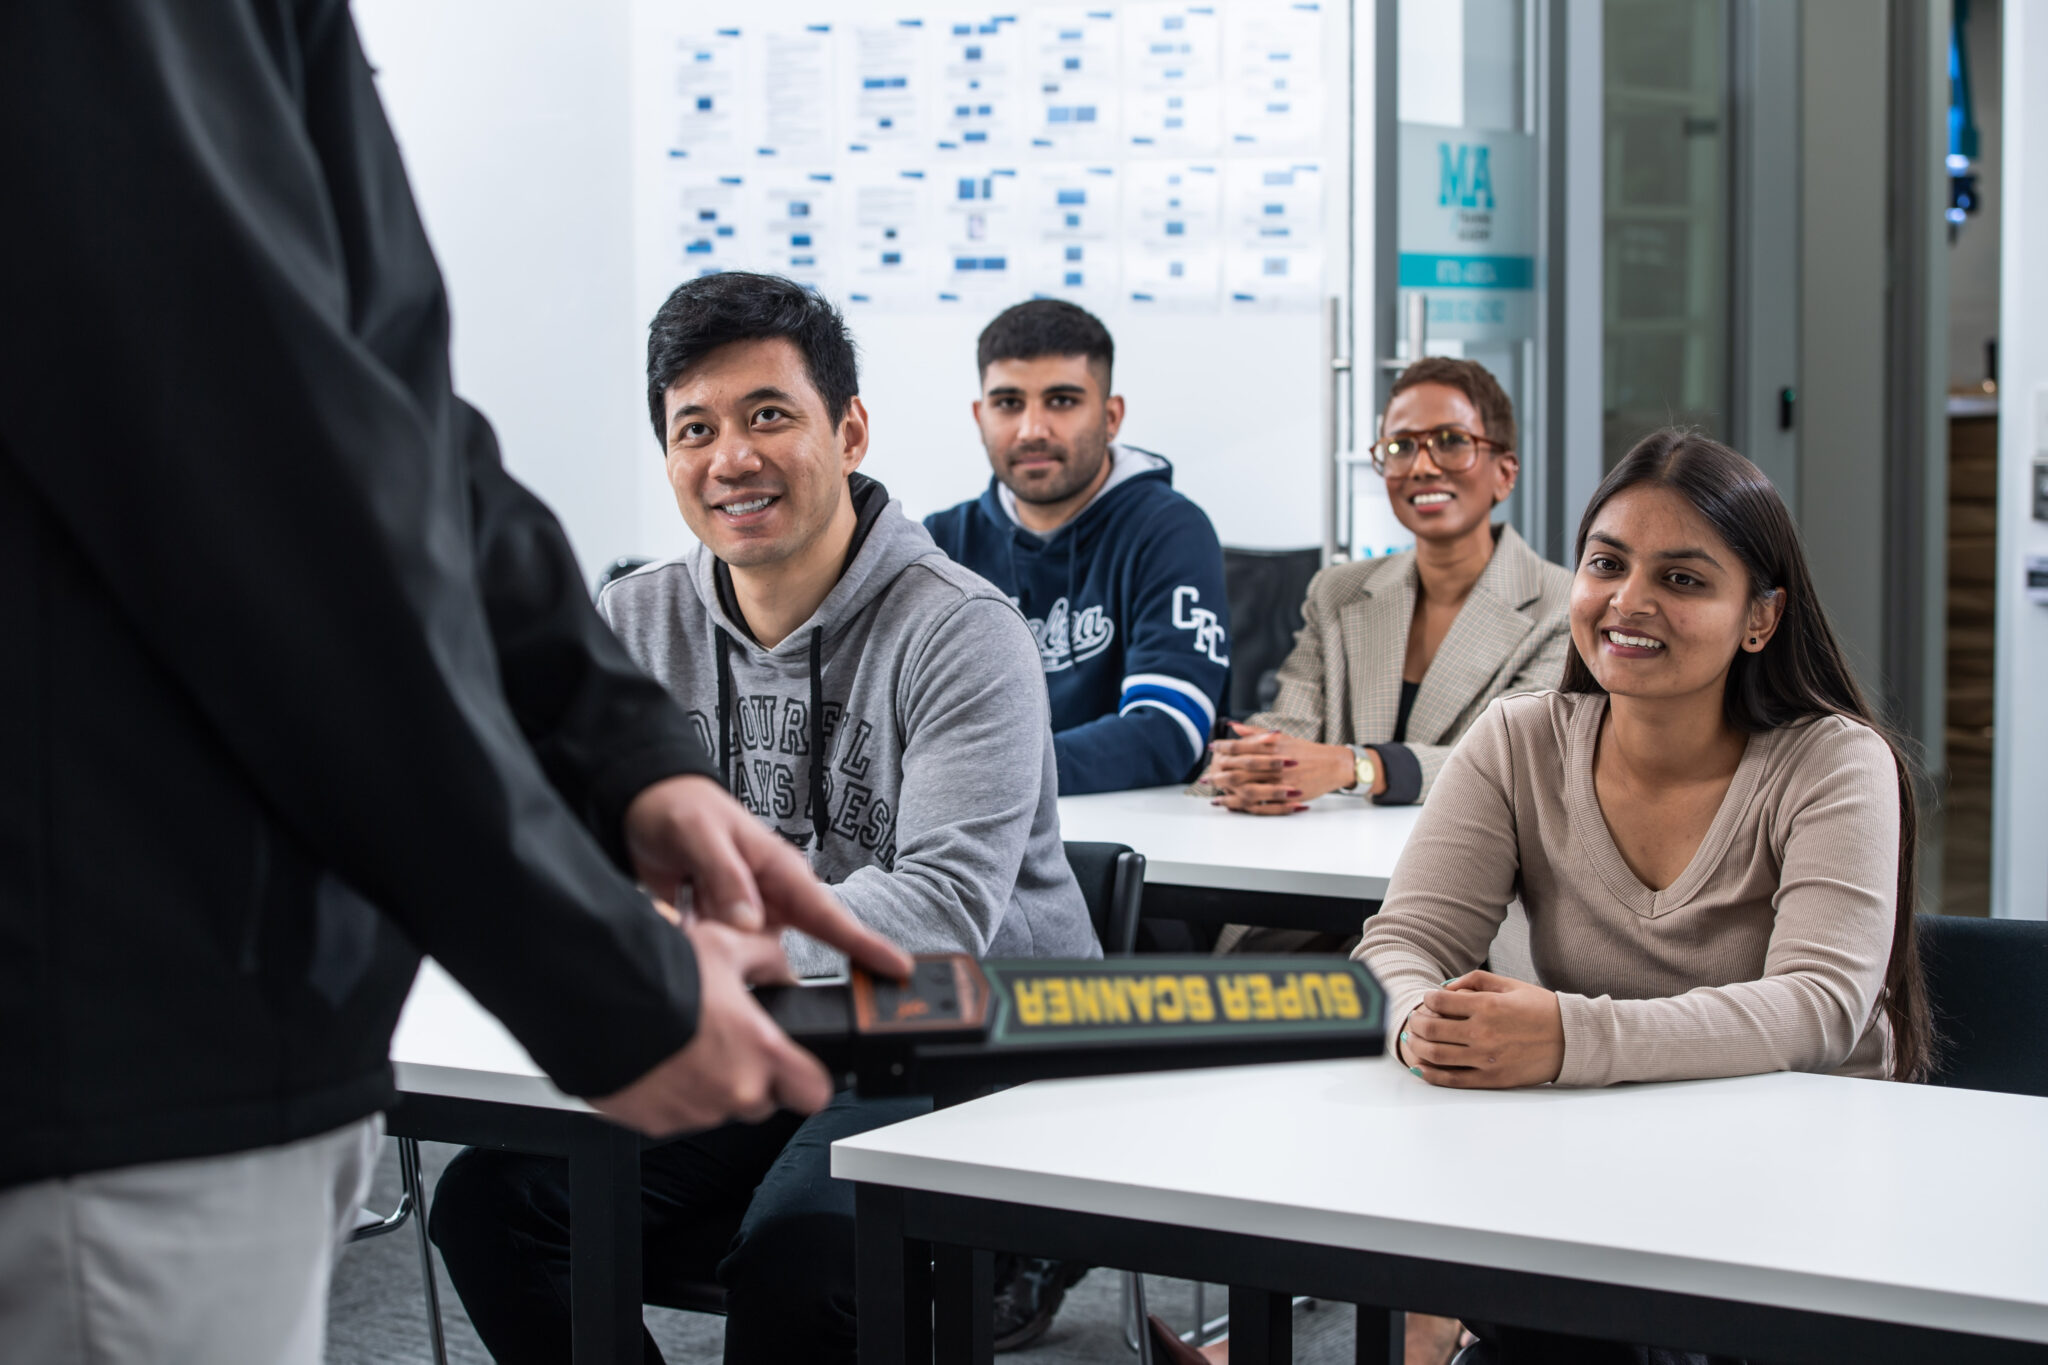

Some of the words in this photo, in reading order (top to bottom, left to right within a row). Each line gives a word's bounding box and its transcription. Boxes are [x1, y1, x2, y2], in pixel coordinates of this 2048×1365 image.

[1437, 141, 1496, 209] MA
[1014, 976, 1213, 1025] SCANNER
[1218, 973, 1361, 1019] SUPER
